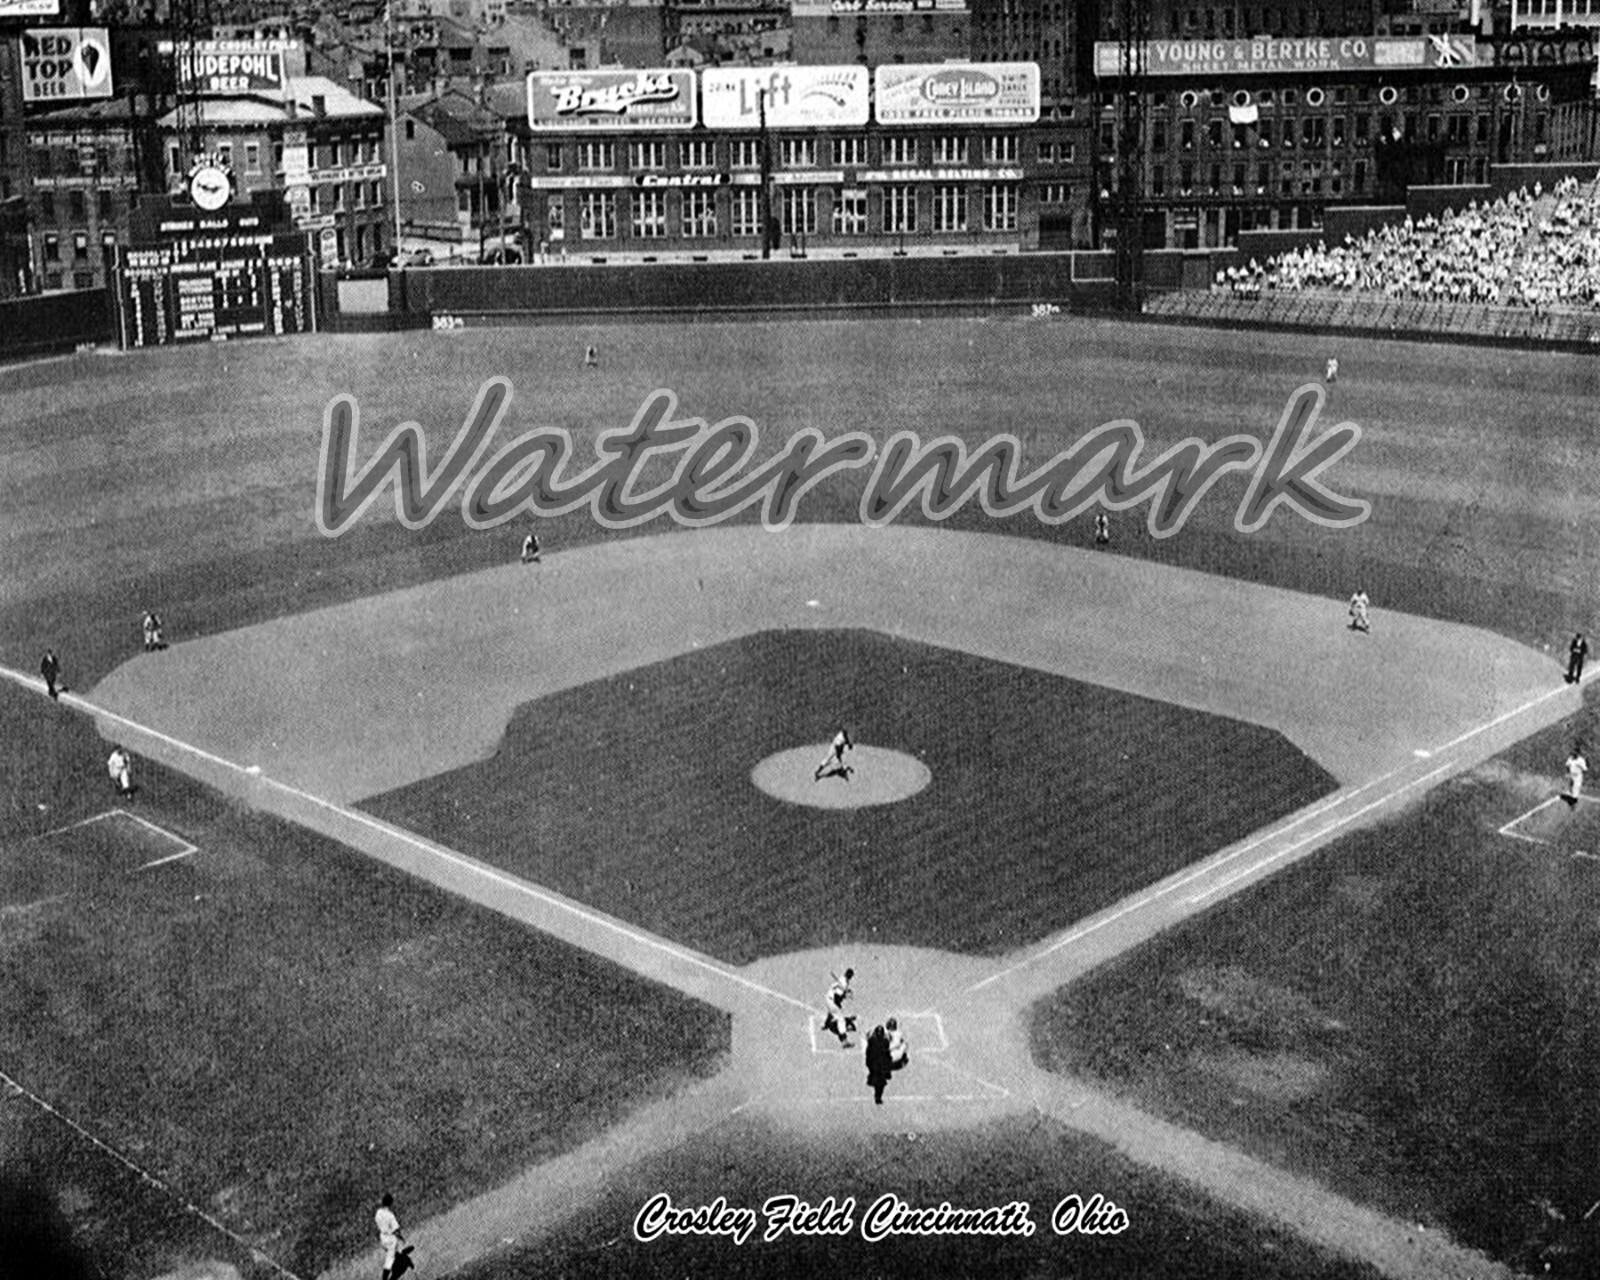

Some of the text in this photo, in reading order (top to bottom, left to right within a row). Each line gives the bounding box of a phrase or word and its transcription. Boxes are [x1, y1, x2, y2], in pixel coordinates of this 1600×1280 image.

[22, 35, 72, 57] RED
[1156, 42, 1226, 62] YOUNG
[1233, 45, 1245, 60] &
[1251, 40, 1331, 61] BERTKE
[24, 60, 74, 80] TOP
[180, 54, 279, 82] HUDEPOHL
[1182, 59, 1340, 73] SHEET METAL WORK
[33, 81, 67, 97] BEER
[209, 76, 249, 90] BEER
[739, 72, 793, 116] Lift
[642, 173, 721, 186] Central
[893, 169, 933, 180] REGAL
